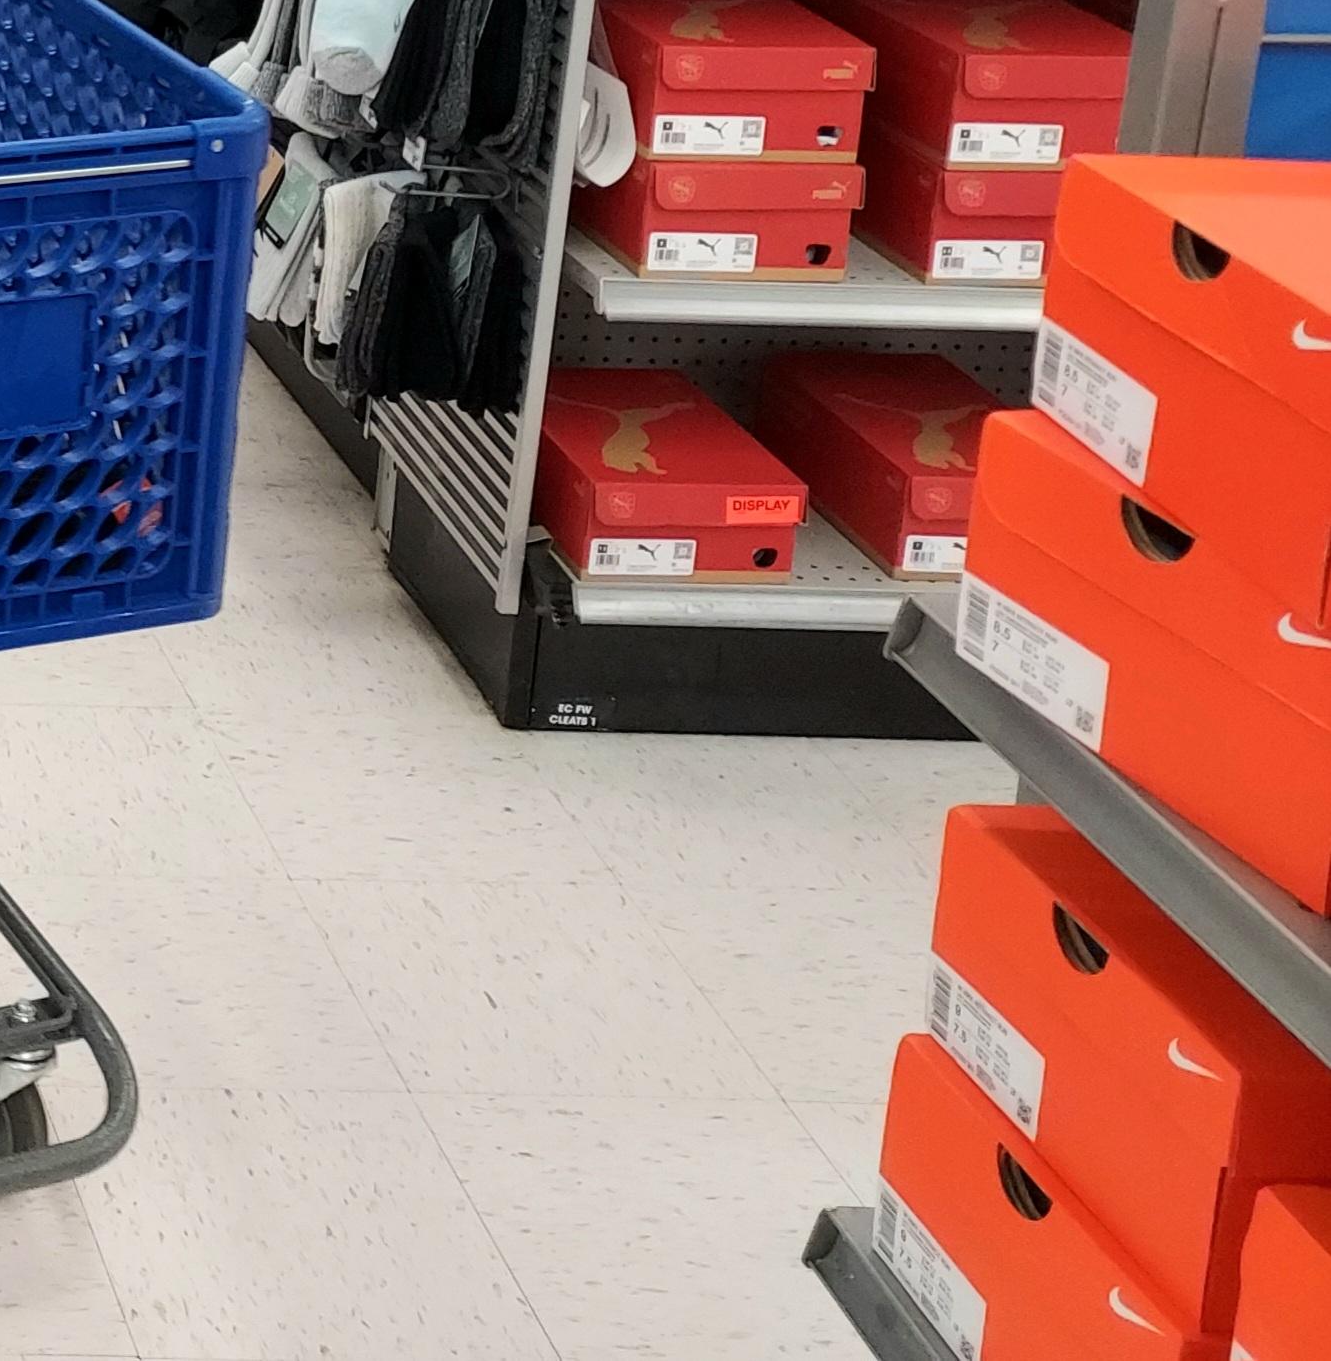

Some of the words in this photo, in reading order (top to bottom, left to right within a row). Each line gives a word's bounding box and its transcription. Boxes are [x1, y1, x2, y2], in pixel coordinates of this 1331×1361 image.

[733, 499, 791, 512] DISPLAY
[993, 620, 1011, 641] 8.5
[992, 640, 999, 652] 7
[558, 703, 574, 714] EC
[575, 704, 593, 715] FW
[549, 714, 588, 726] CLEATS
[589, 716, 597, 727] 1
